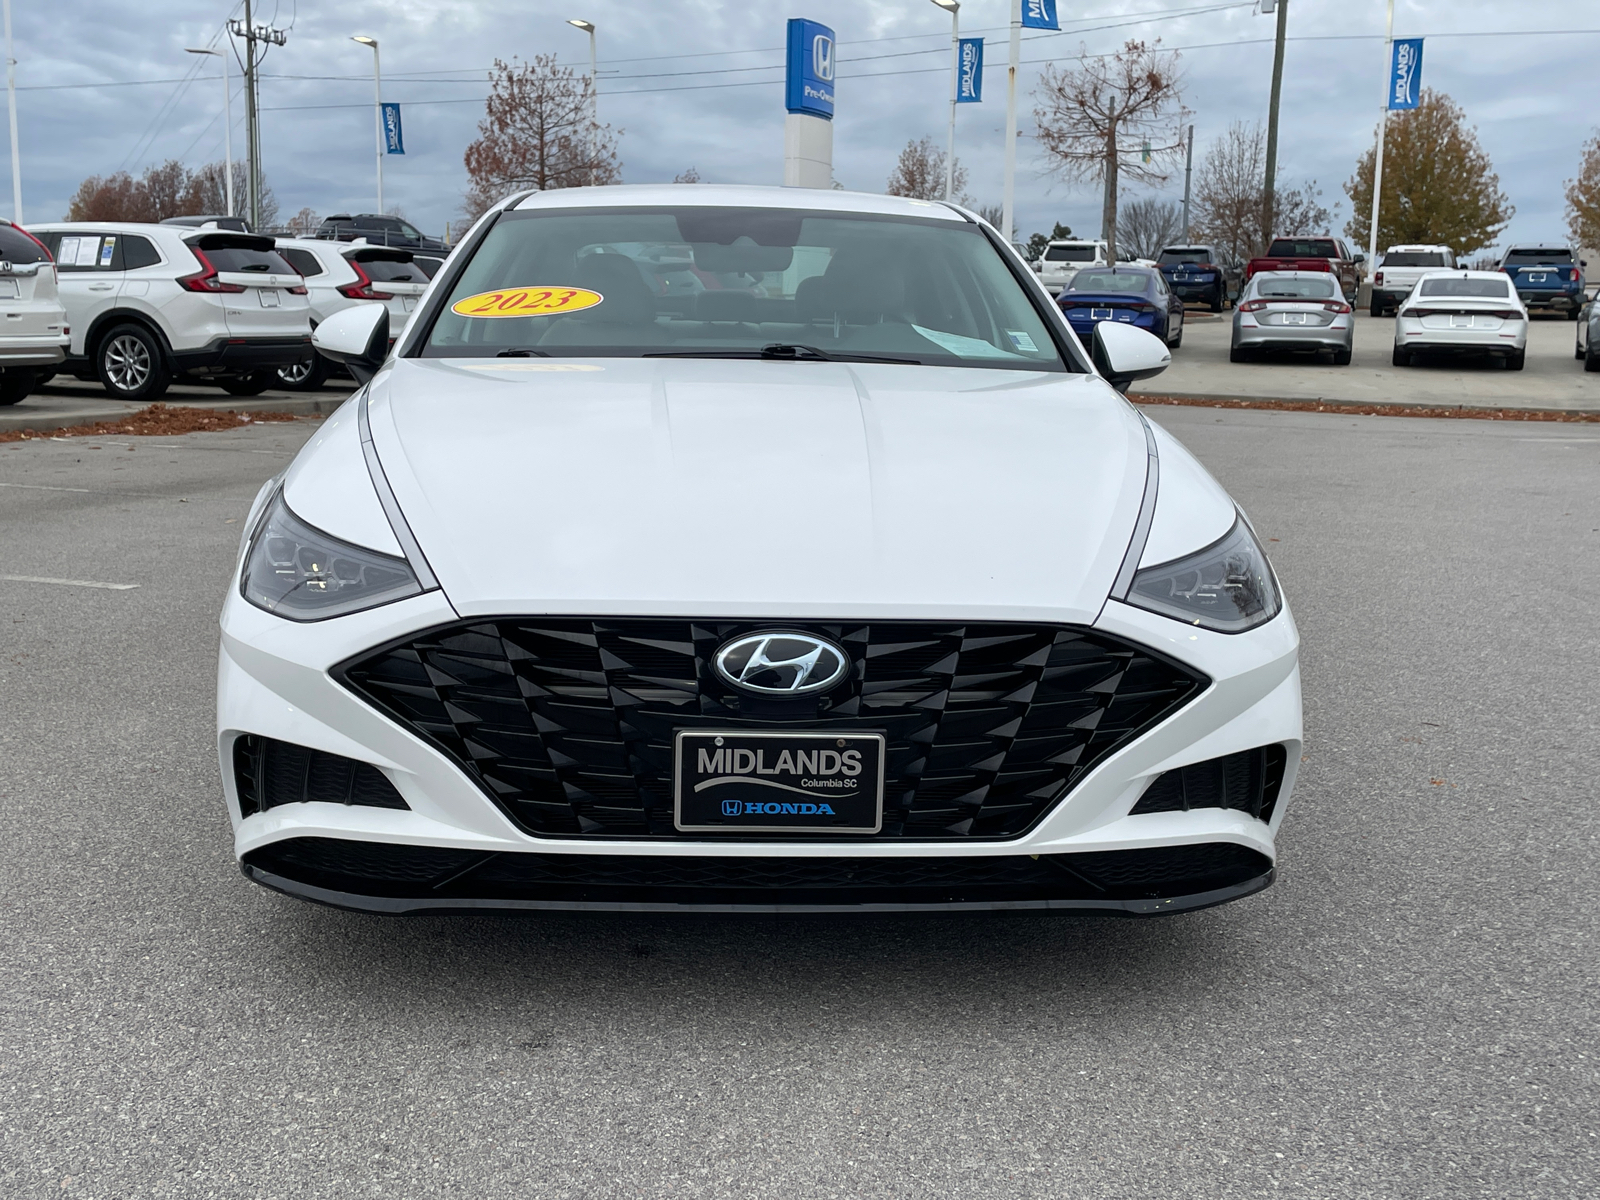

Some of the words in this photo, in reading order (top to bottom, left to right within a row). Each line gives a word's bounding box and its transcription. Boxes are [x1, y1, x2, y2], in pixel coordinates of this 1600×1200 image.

[961, 43, 973, 97] MIDLANDS
[1395, 43, 1409, 103] MIDLANDS
[385, 106, 396, 150] MIDLANDS
[469, 291, 577, 313] 2023
[698, 748, 862, 776] MIDLANDS
[801, 778, 843, 788] Columbia
[843, 779, 857, 788] SC
[744, 802, 835, 815] HONDA
